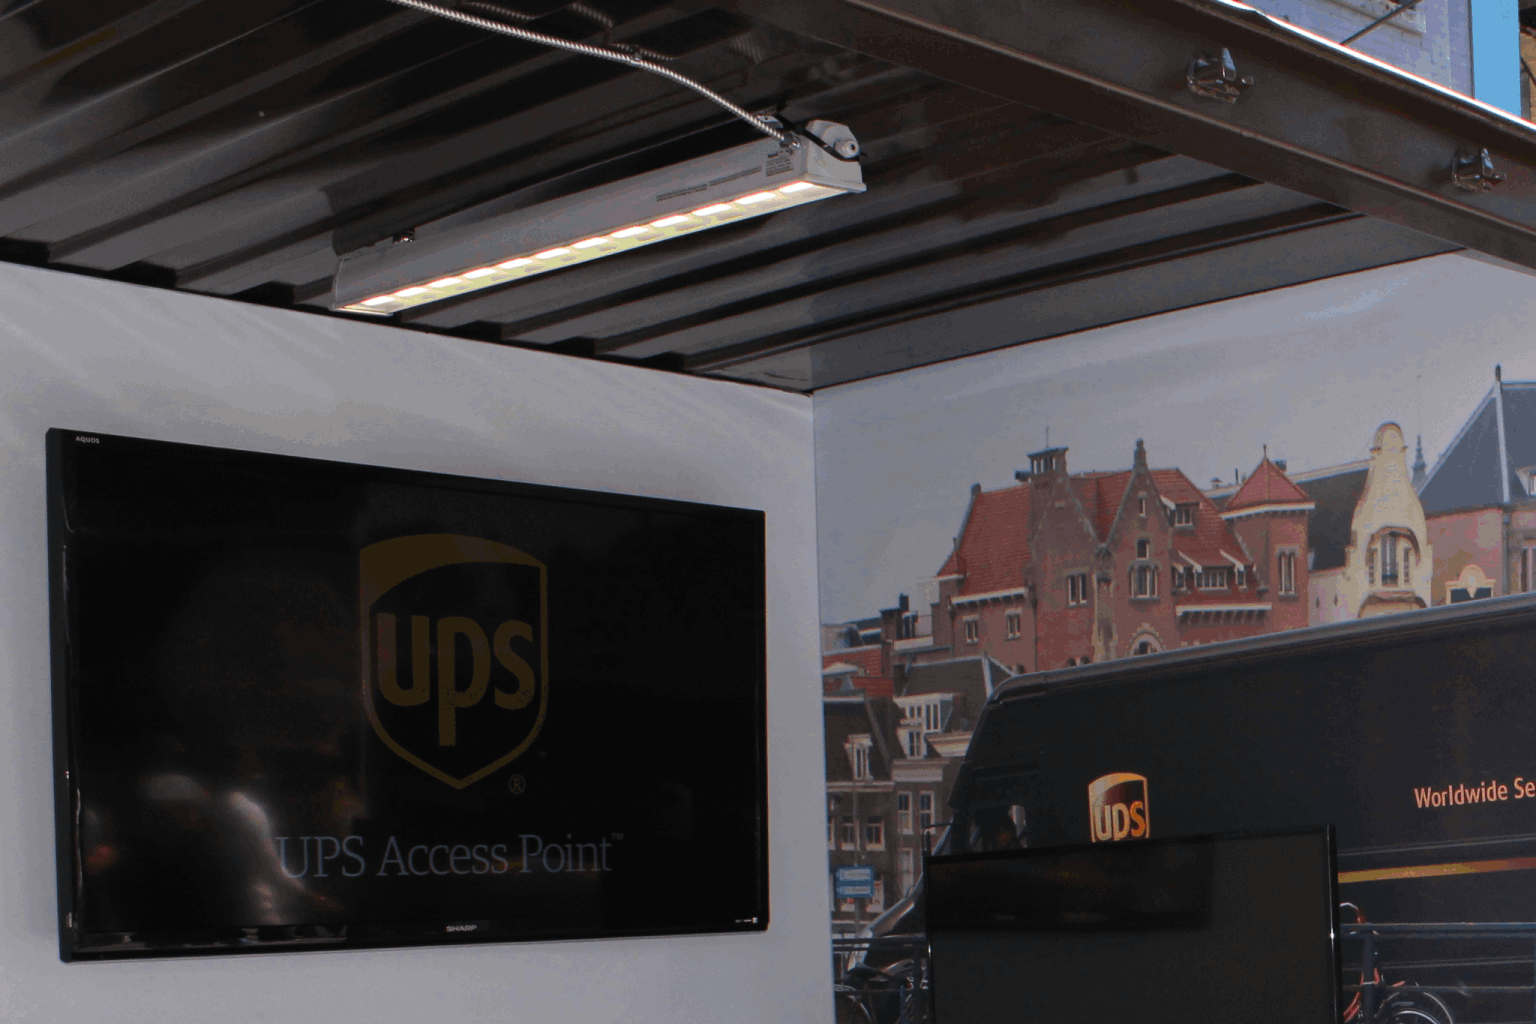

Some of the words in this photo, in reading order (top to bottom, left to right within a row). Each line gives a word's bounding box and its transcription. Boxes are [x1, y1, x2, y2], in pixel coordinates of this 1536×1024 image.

[376, 612, 536, 747] ups
[1413, 780, 1508, 808] Worldwide
[275, 835, 366, 879] UPS
[376, 835, 508, 877] Access
[445, 924, 478, 933] SHARP
